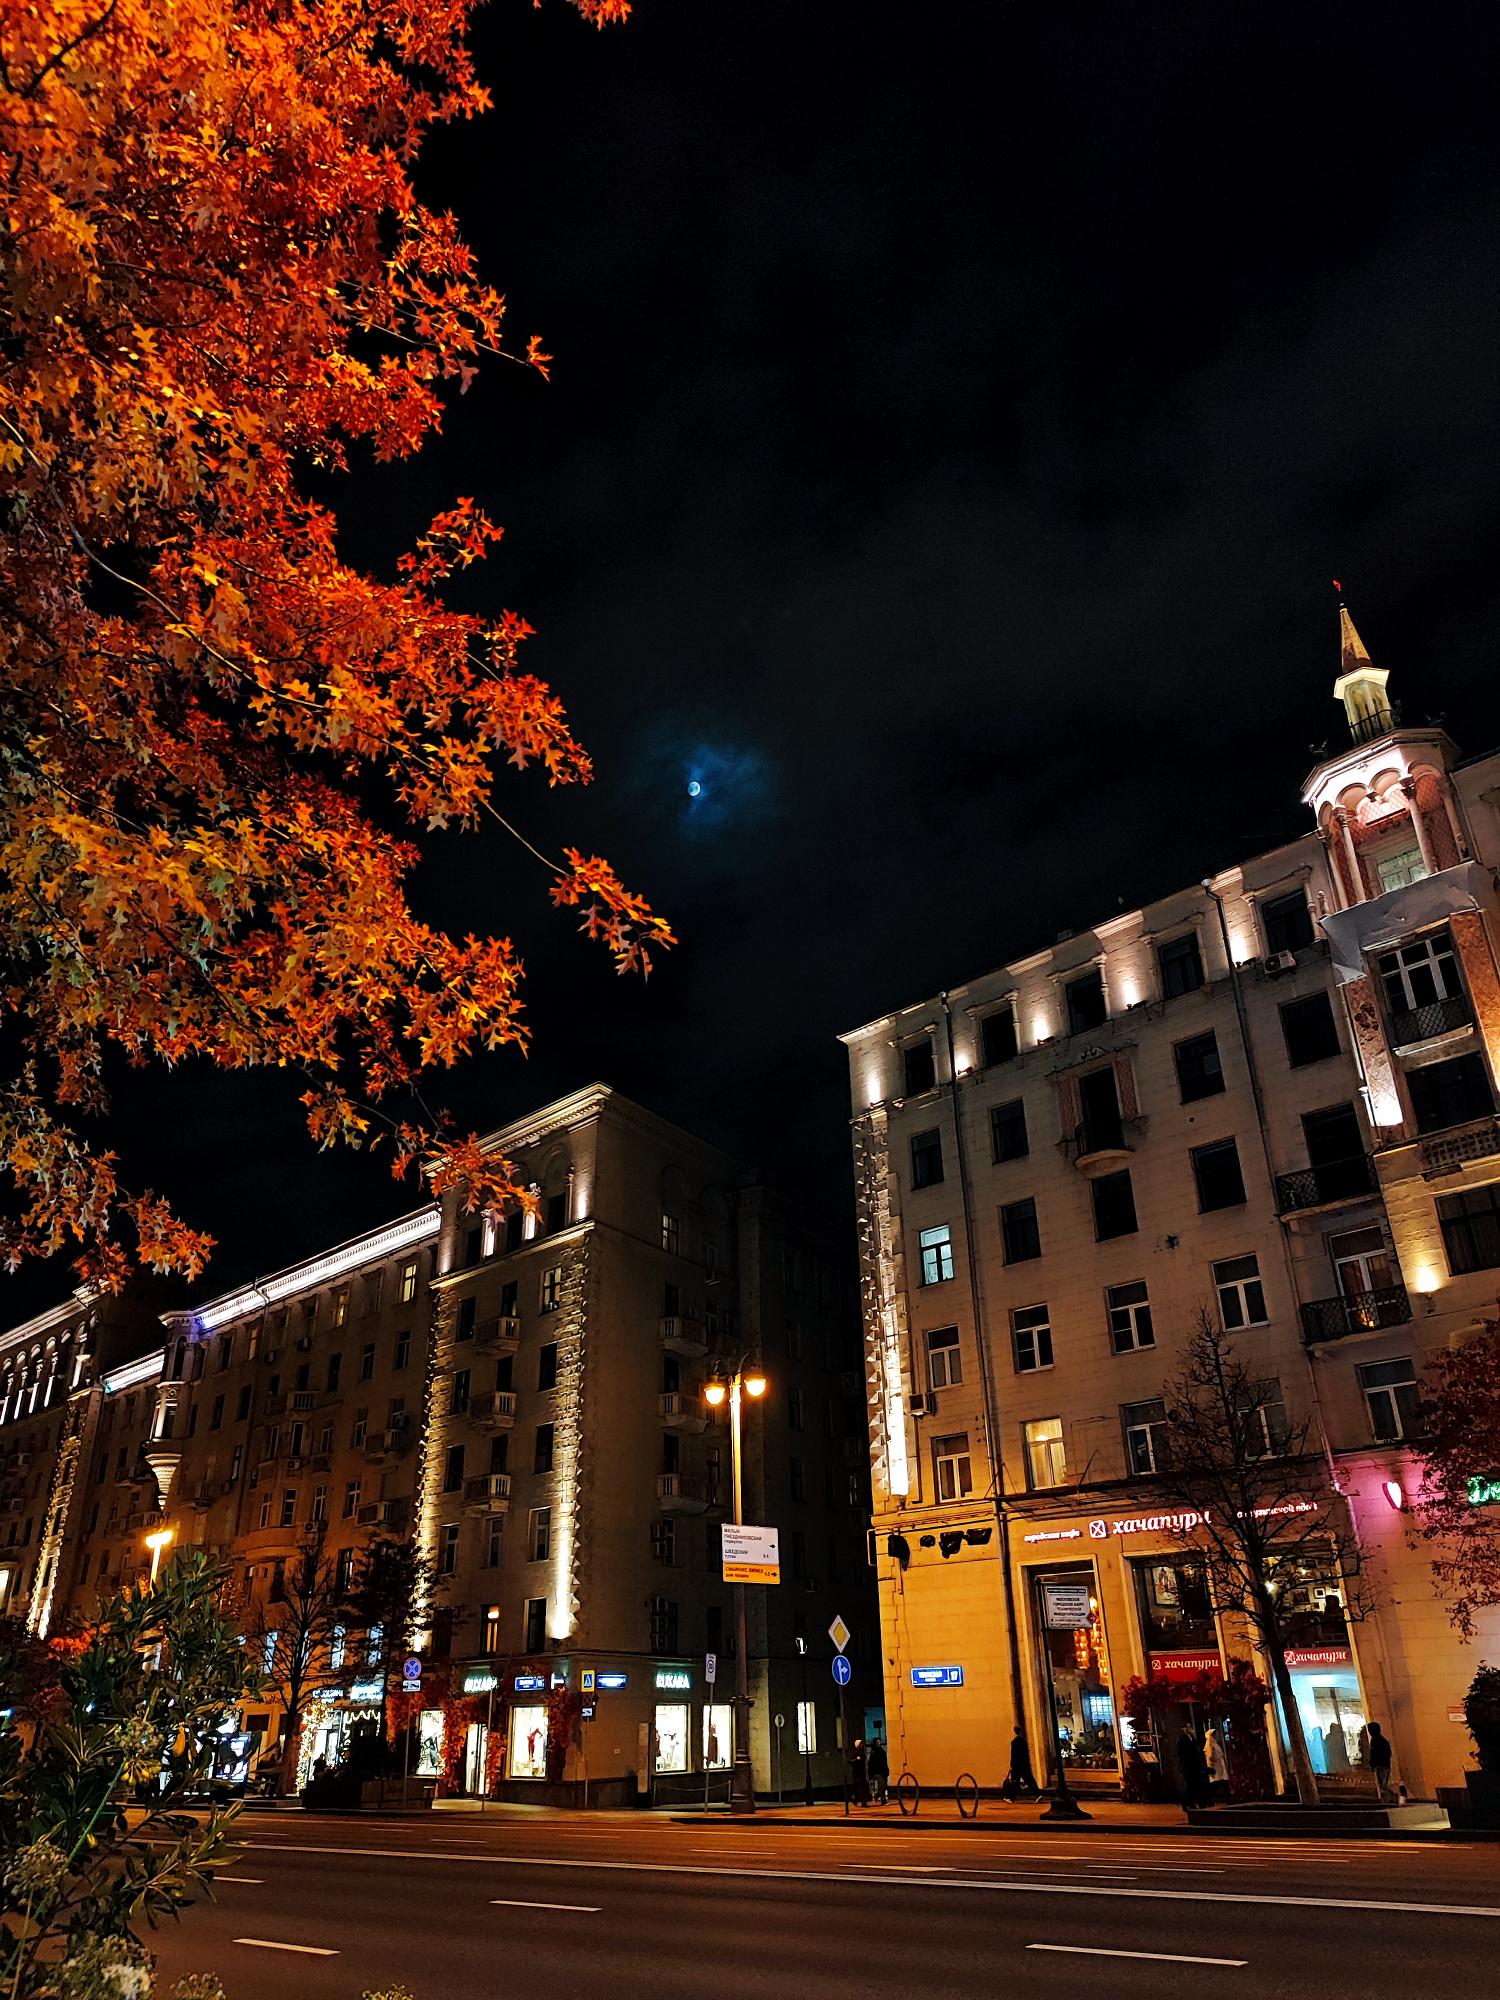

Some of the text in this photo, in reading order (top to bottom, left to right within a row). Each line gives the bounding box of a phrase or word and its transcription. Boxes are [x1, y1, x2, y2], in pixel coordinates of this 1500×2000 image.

[1112, 1510, 1212, 1534] хачапури
[1295, 1650, 1346, 1664] хачапури
[1164, 1658, 1219, 1673] хачапури
